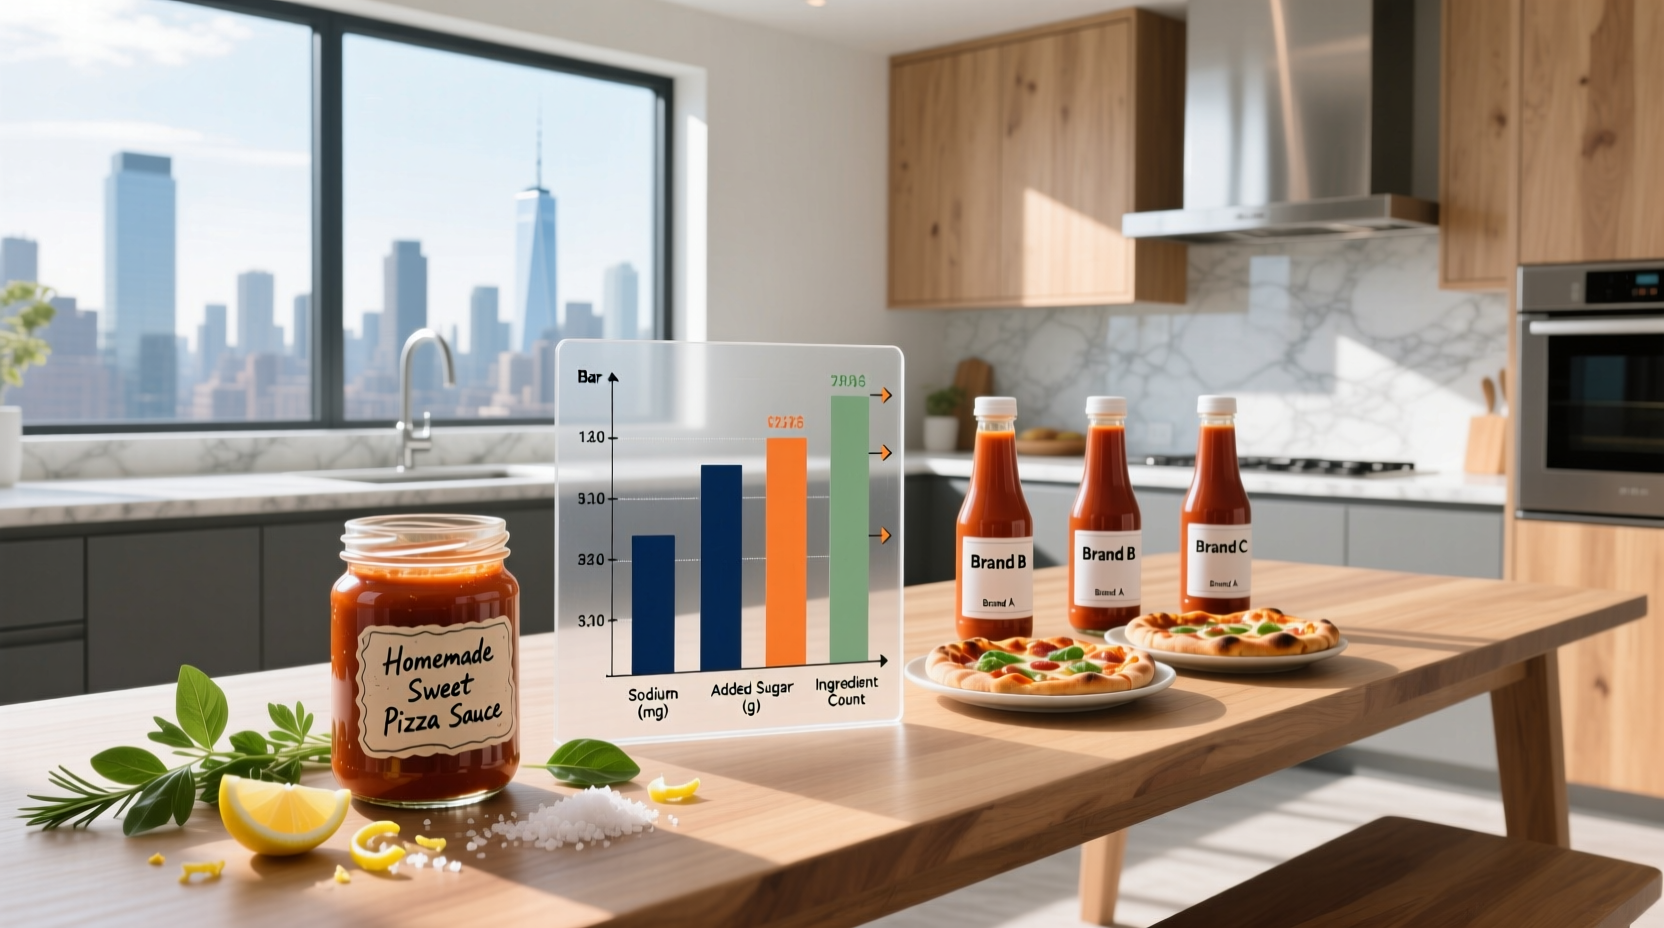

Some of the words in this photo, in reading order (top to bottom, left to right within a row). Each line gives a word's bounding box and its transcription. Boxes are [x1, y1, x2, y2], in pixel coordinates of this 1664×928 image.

[578, 369, 603, 384] Bar
[1082, 546, 1124, 561] Brand
[1127, 546, 1136, 560] B
[1195, 539, 1237, 553] Brand
[1238, 539, 1248, 553] C
[971, 554, 1015, 569] Brand
[1018, 554, 1027, 569] B
[1008, 597, 1016, 607] A
[383, 637, 494, 676] Homemade
[408, 672, 475, 703] Sweet
[710, 681, 752, 697] Added
[756, 680, 794, 697] Sugar
[815, 676, 879, 692] Ingredient
[628, 689, 679, 702] Sodium
[828, 693, 866, 707] Count
[638, 704, 669, 721] (mg)
[742, 699, 761, 716] (g)
[383, 706, 440, 737] Pizza
[449, 702, 503, 728] Sauce
